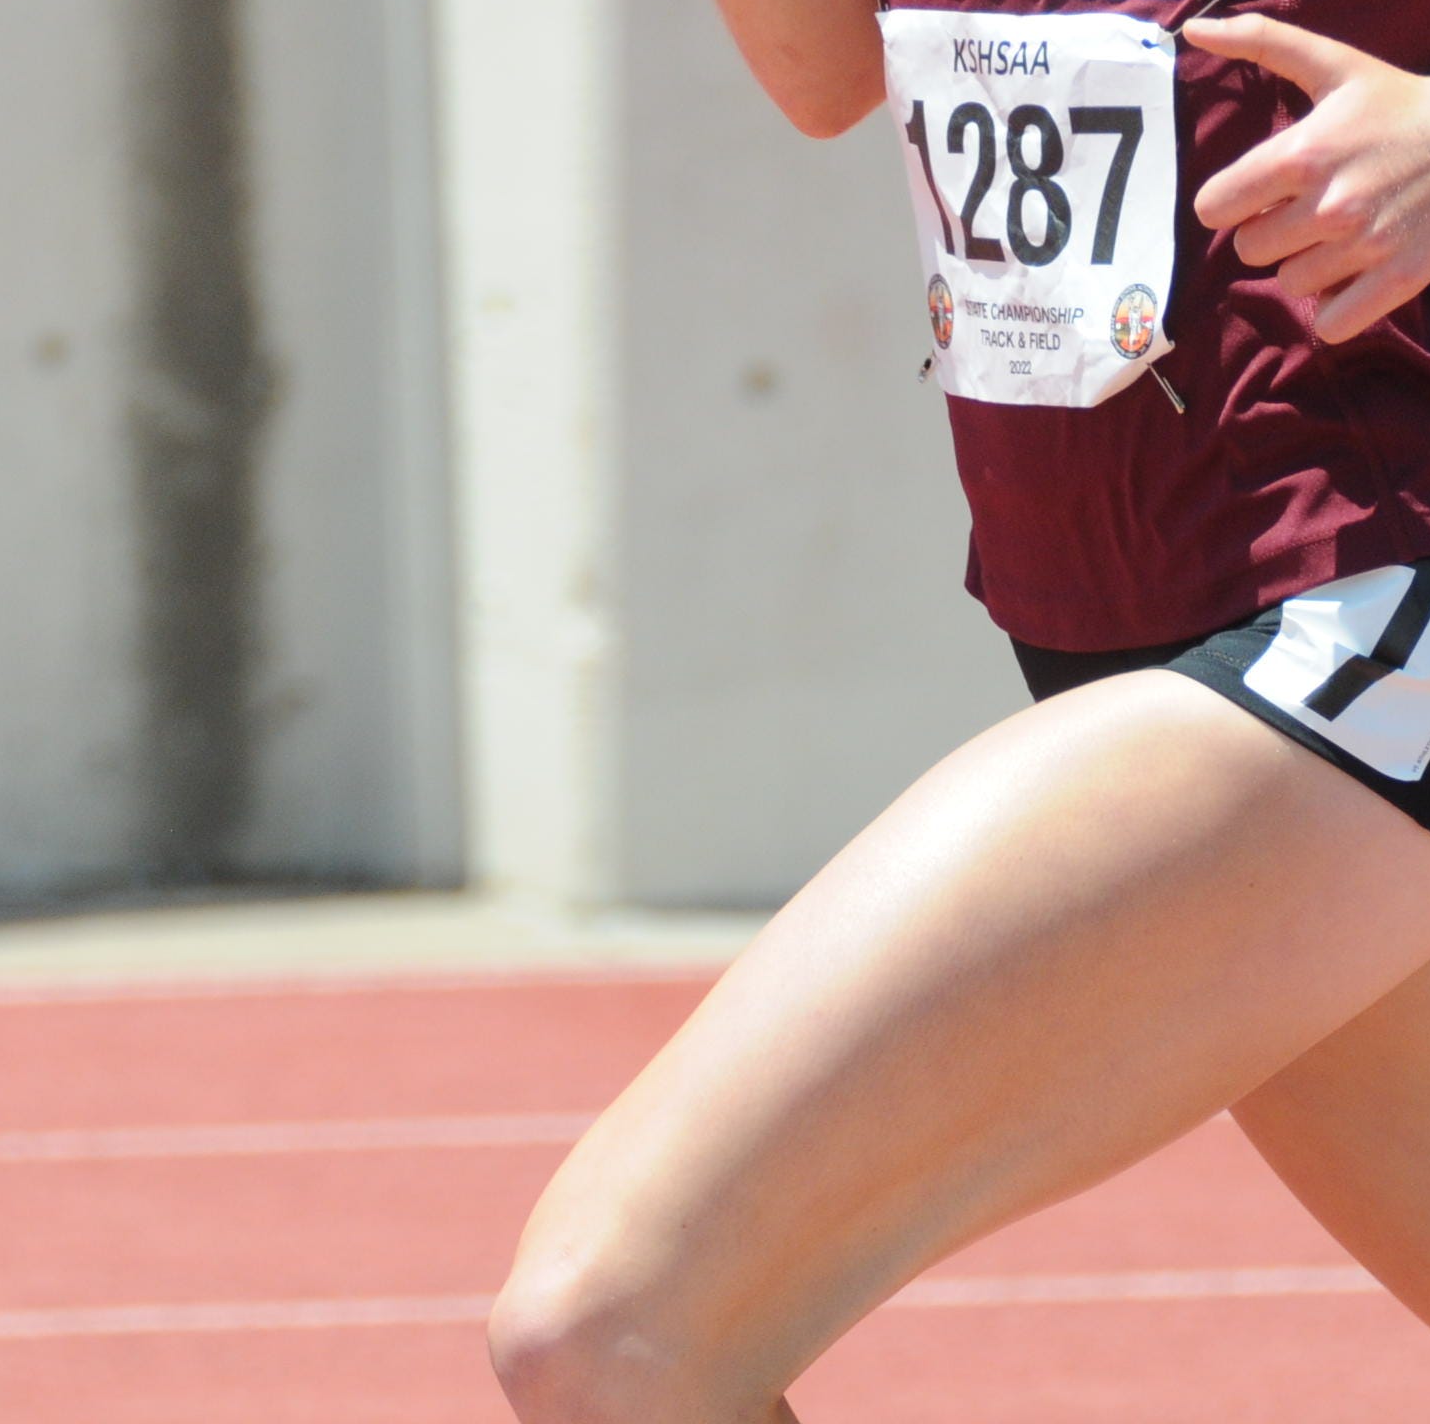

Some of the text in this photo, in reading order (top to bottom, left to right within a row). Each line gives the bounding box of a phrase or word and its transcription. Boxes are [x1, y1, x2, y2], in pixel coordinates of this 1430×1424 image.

[952, 37, 1051, 76] KSHSAA
[904, 99, 1144, 268] 1287
[965, 299, 1084, 325] STATE CHAMPIONSHIP
[980, 329, 1061, 351] TRACK & FIELD
[1009, 360, 1032, 375] 2022
